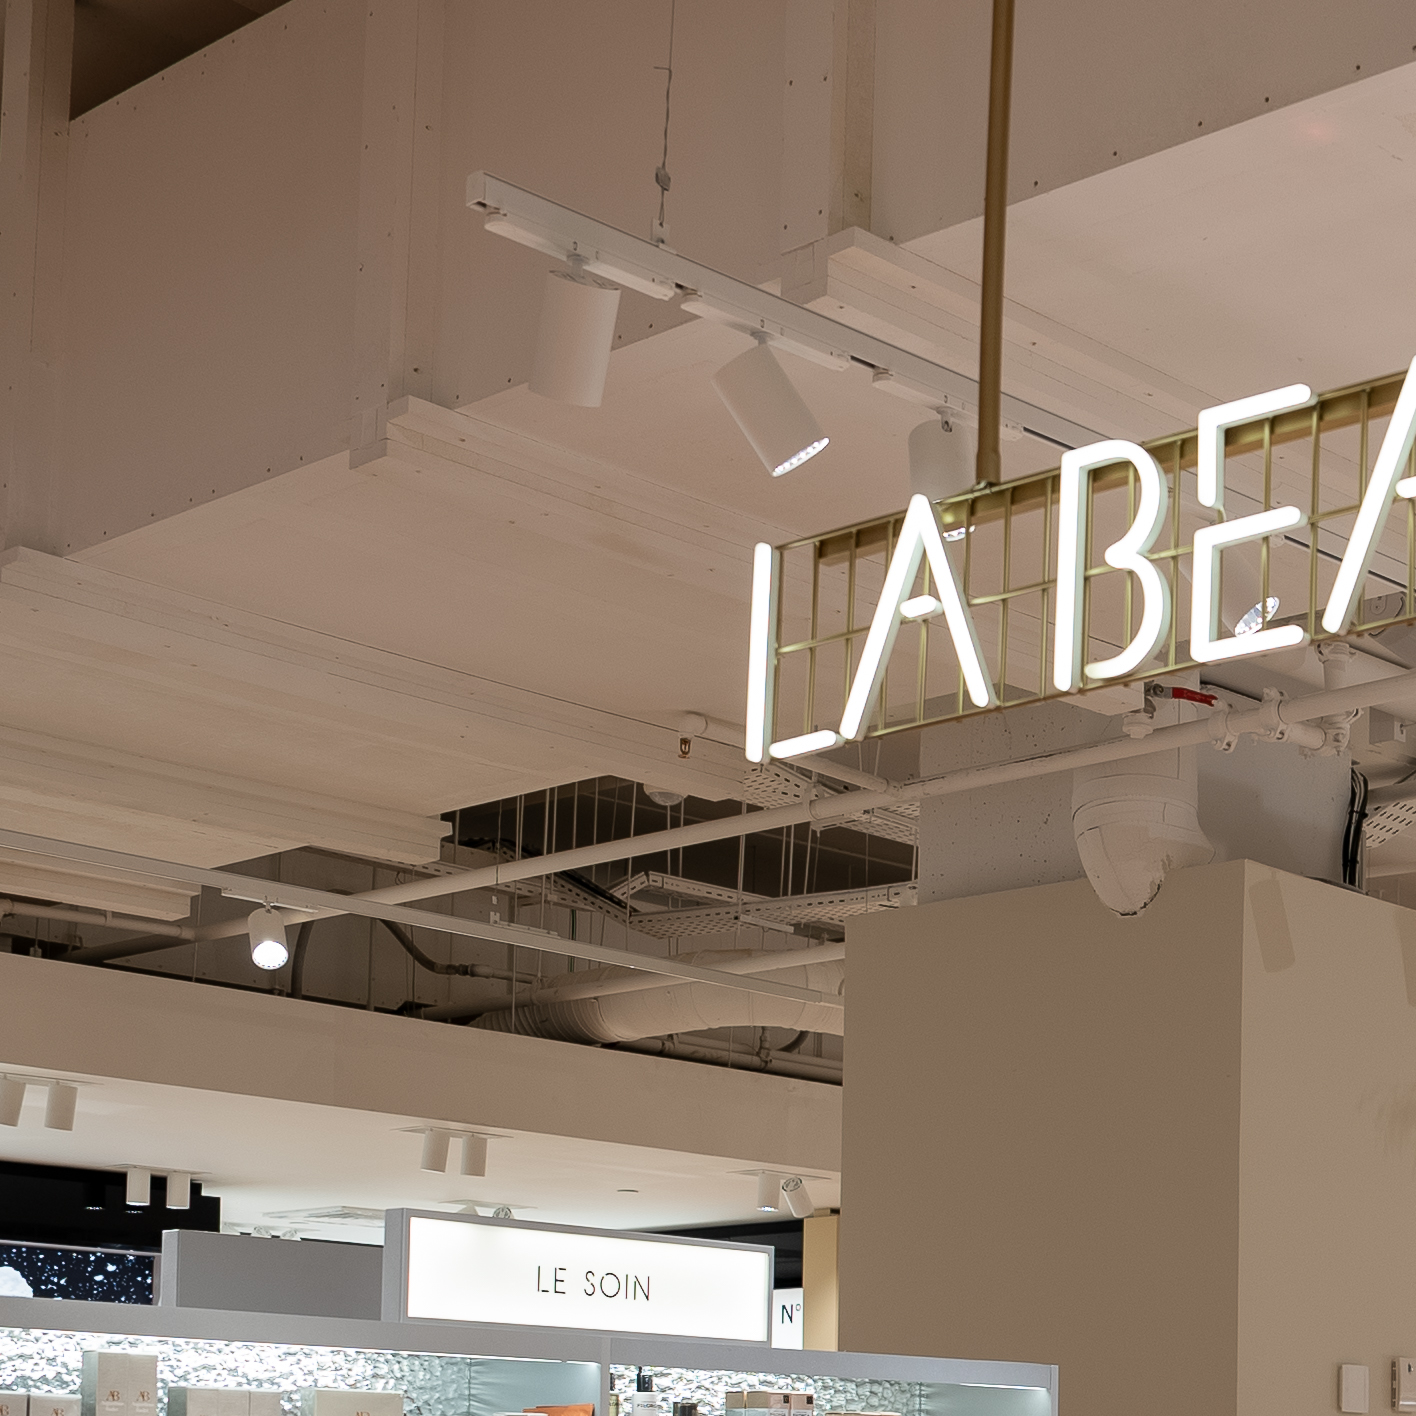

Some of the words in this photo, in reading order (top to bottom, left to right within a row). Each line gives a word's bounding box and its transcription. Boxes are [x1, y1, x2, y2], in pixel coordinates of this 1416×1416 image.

[746, 494, 995, 764] LA
[537, 1265, 566, 1294] LE
[584, 1270, 651, 1301] SOIN
